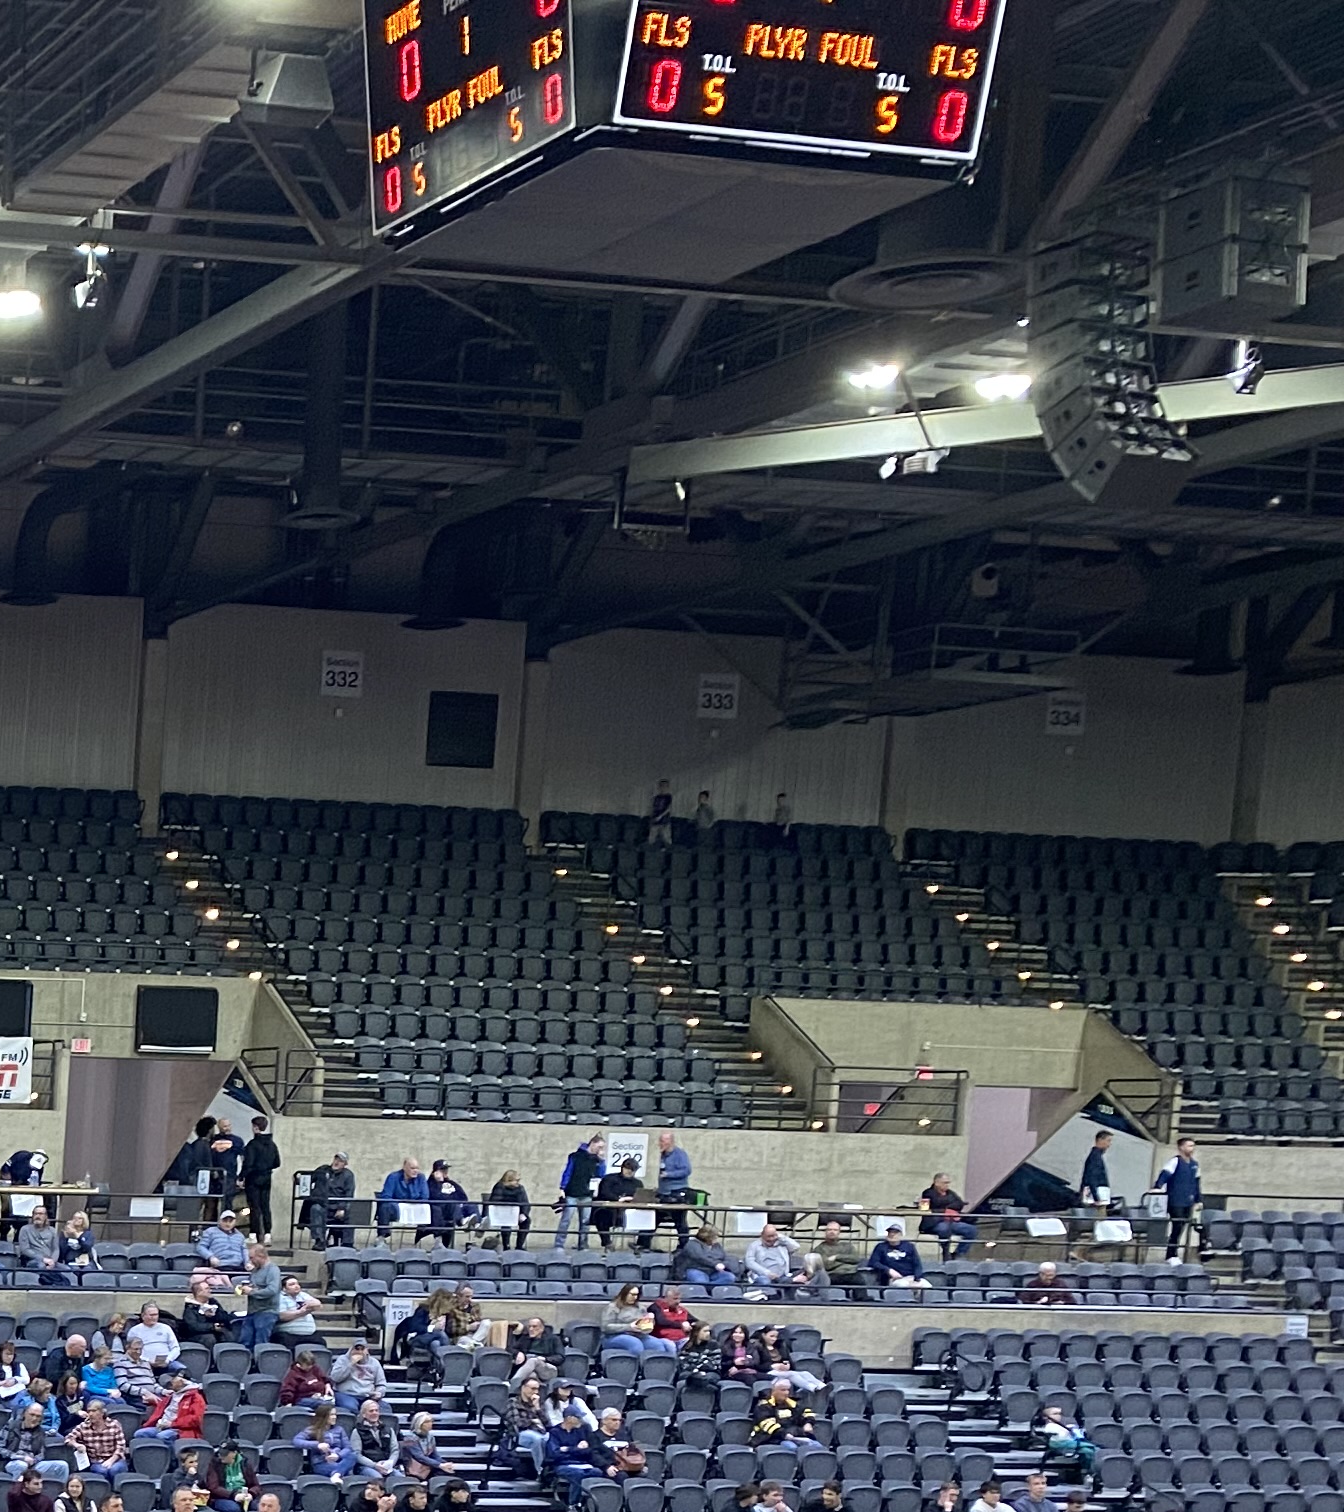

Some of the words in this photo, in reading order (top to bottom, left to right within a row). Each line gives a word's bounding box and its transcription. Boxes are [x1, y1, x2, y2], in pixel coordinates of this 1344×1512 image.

[531, 28, 563, 70] FLS
[641, 12, 691, 48] FLS
[743, 24, 807, 61] PLYR
[818, 33, 878, 70] FOUL
[400, 40, 421, 101] 0
[929, 44, 979, 79] FLS
[466, 65, 503, 109] FOUL
[544, 73, 563, 124] 0
[649, 60, 681, 112] 0
[703, 76, 726, 115] 5
[876, 95, 898, 134] 5
[936, 90, 968, 142] 0
[373, 125, 401, 163] FLS
[384, 166, 402, 213] 0
[325, 670, 358, 688] 332
[702, 693, 733, 709] 333
[1, 1053, 19, 1062] FM
[612, 1142, 644, 1150] Section
